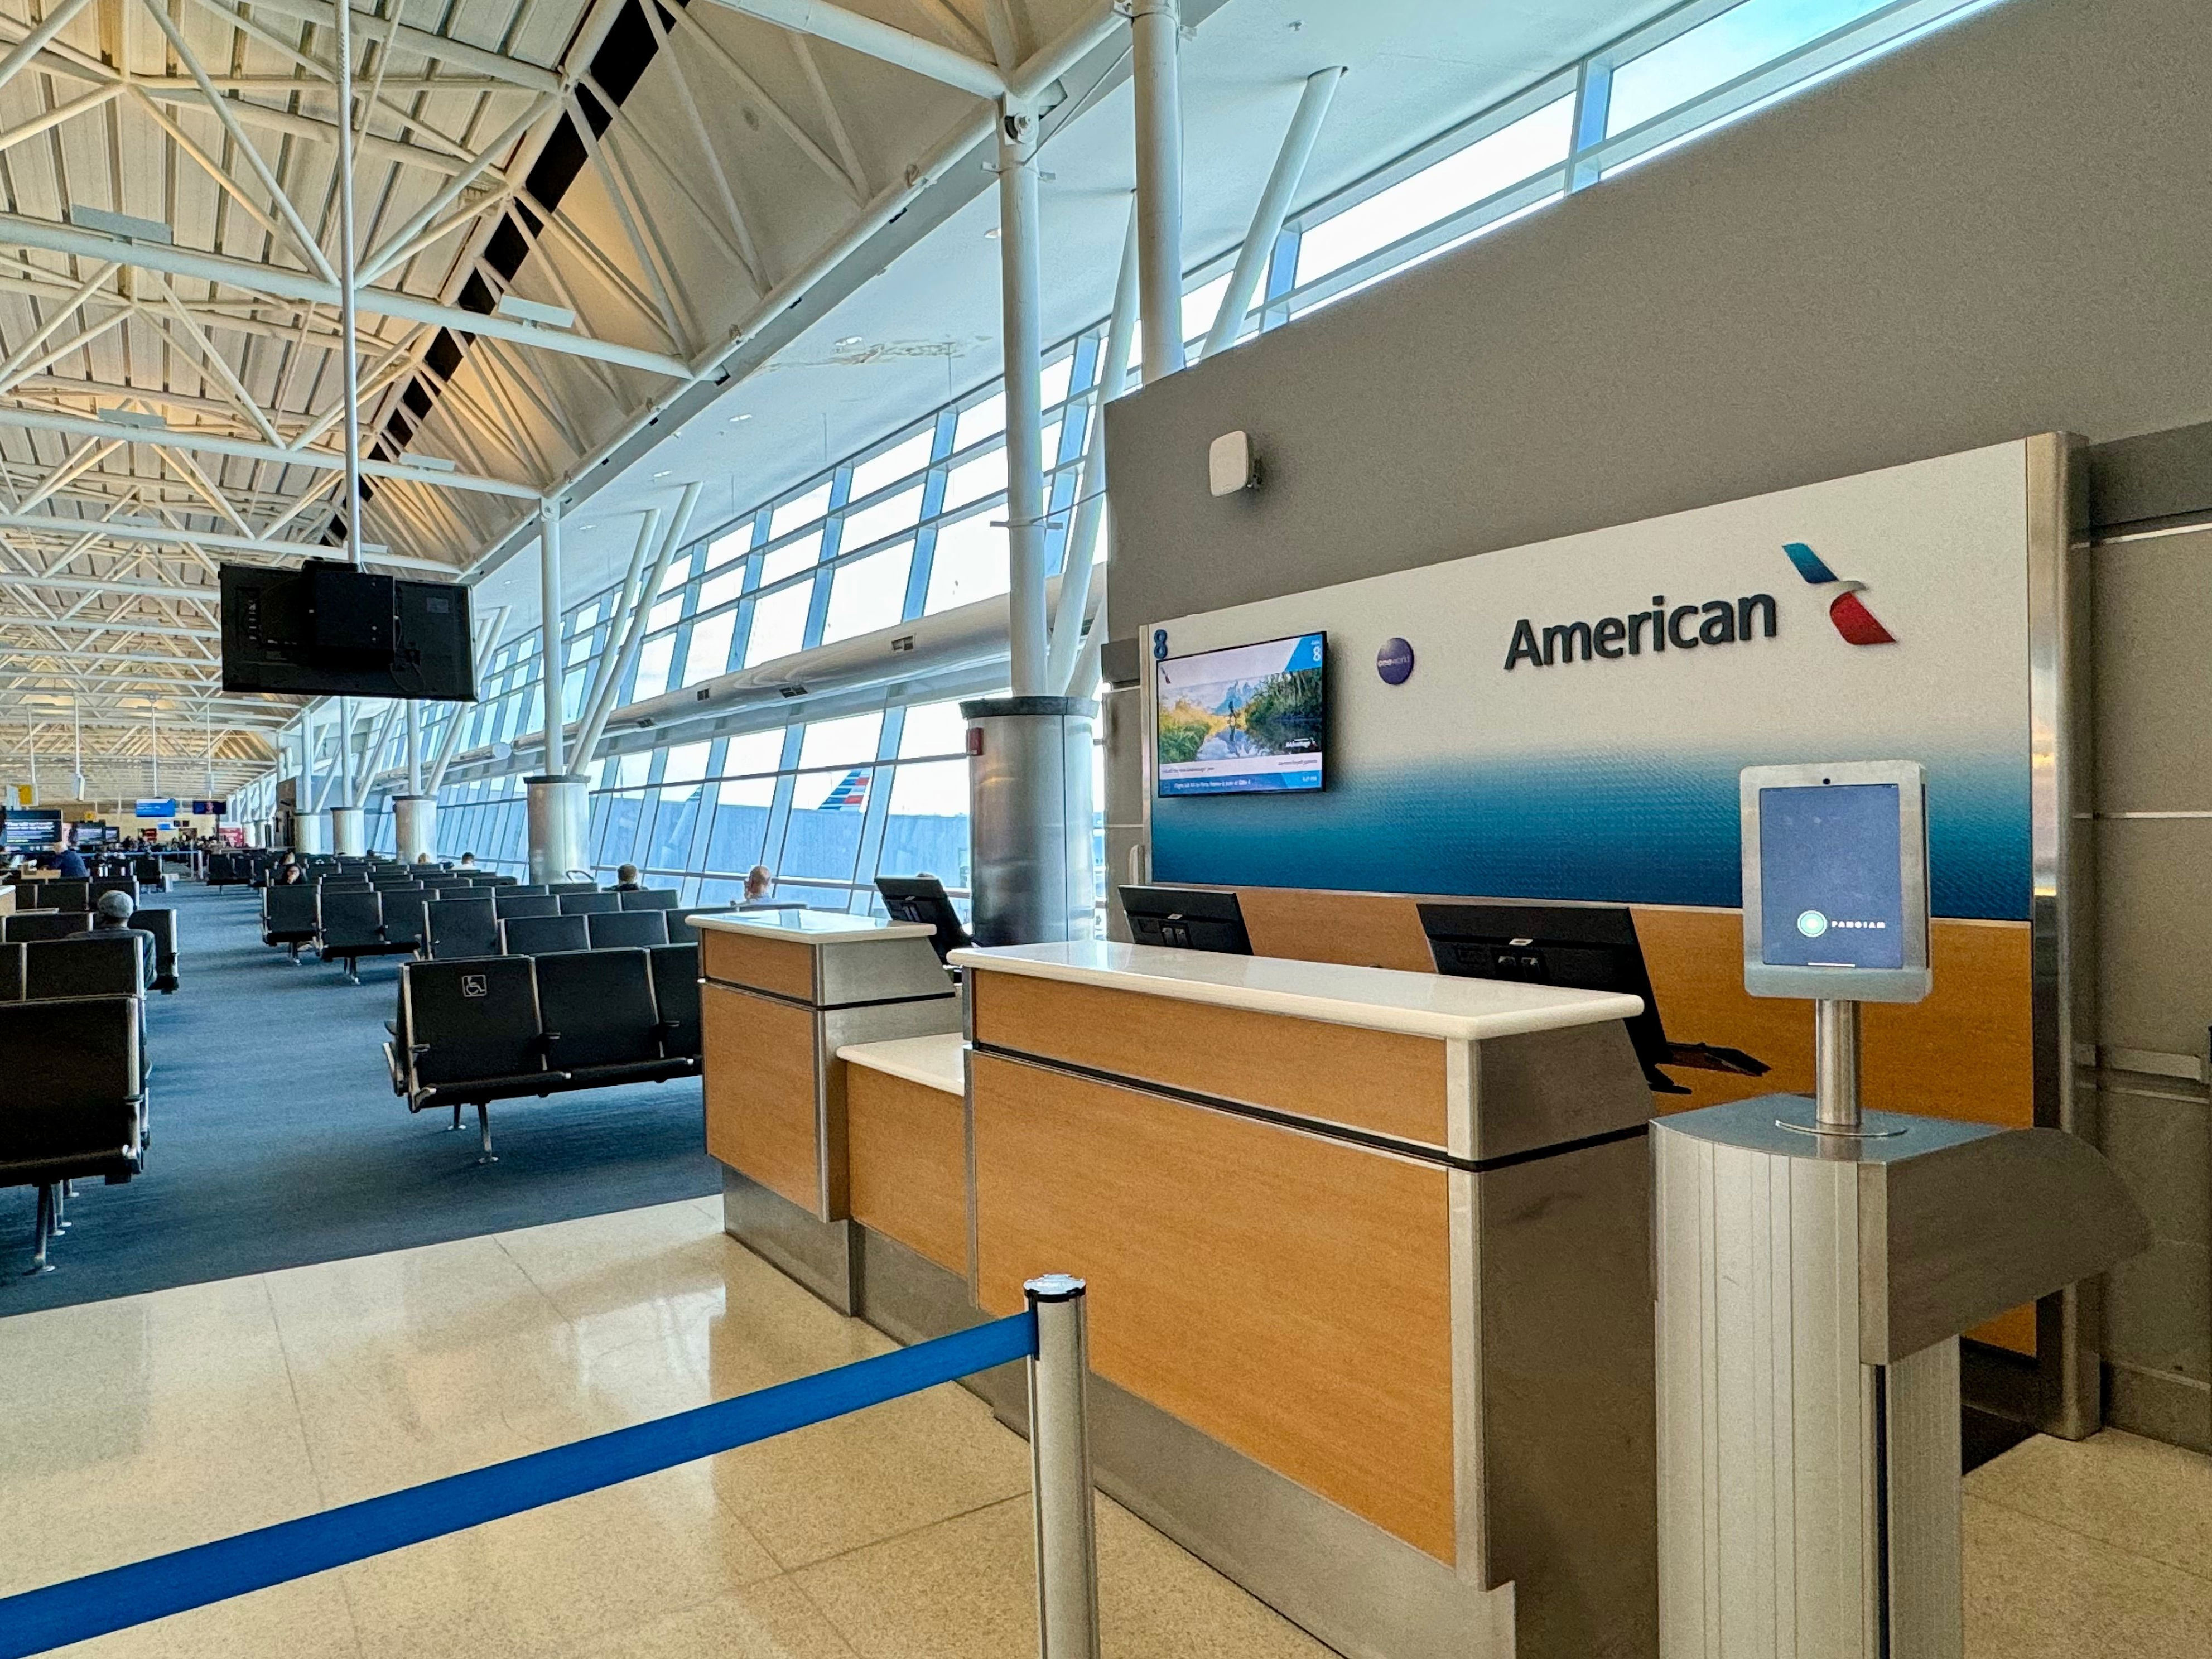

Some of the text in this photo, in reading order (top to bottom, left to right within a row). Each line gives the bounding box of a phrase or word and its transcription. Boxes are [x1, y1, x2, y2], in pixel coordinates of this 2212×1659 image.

[1154, 629, 1168, 659] 8
[1503, 594, 1776, 670] American
[1313, 645, 1321, 662] 8
